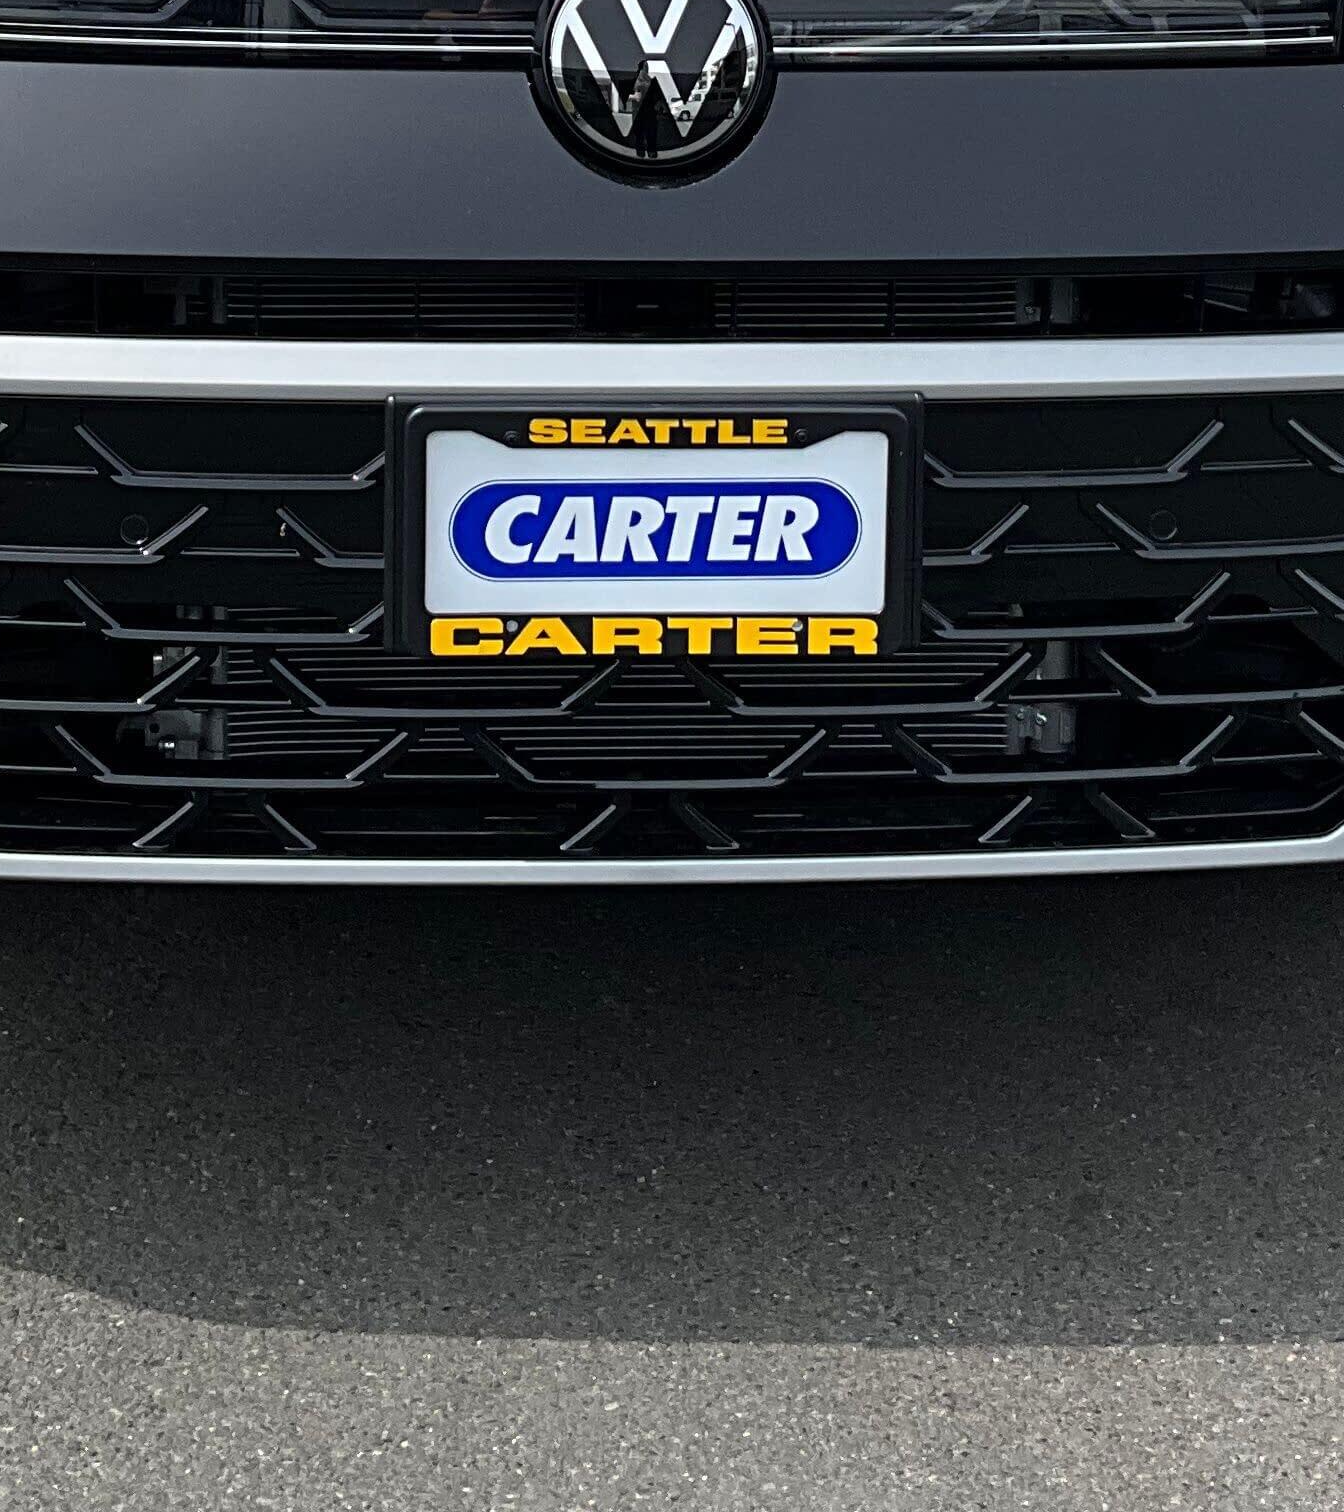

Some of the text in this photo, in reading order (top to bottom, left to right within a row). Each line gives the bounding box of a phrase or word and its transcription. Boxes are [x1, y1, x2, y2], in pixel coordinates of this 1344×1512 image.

[528, 418, 788, 444] SEATTLE
[484, 494, 819, 564] CARTER
[430, 617, 878, 655] CARTER
